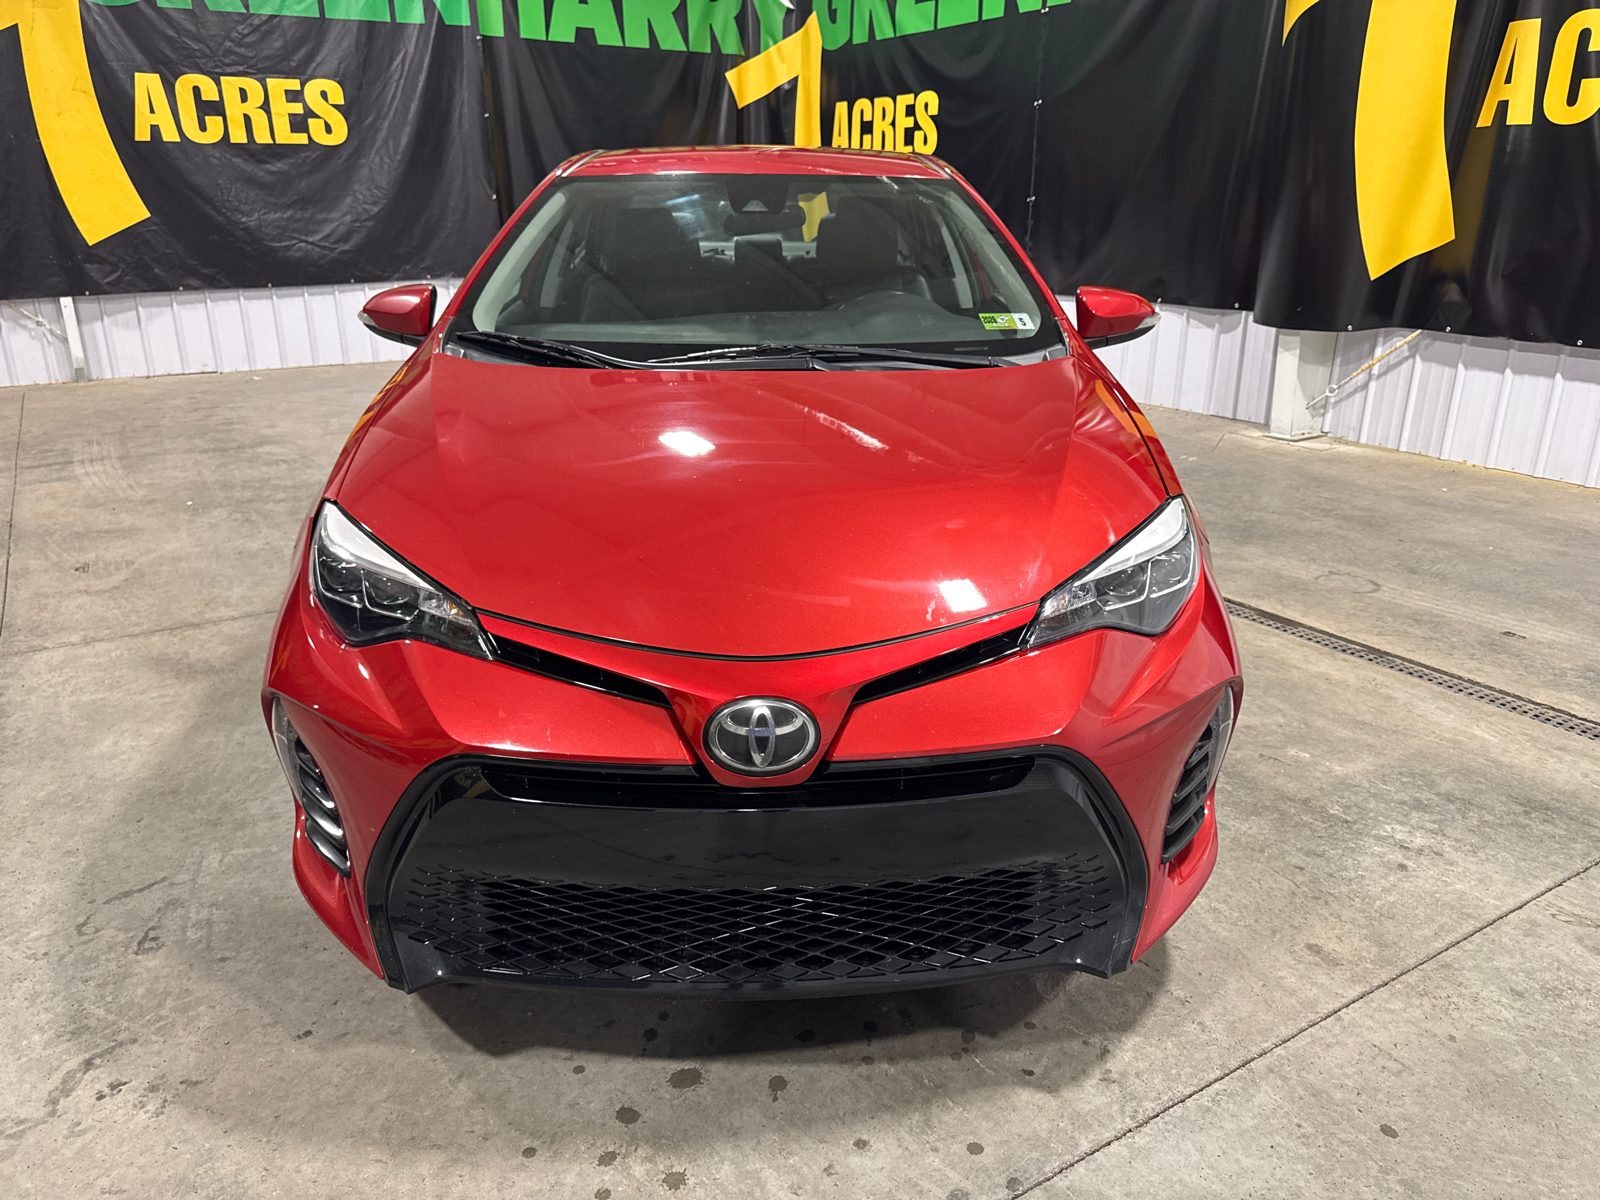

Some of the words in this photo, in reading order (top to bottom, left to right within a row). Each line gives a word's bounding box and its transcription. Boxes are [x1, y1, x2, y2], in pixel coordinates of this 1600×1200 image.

[134, 72, 349, 146] ACRES
[832, 90, 939, 156] ACRES
[1018, 317, 1027, 327] 5
